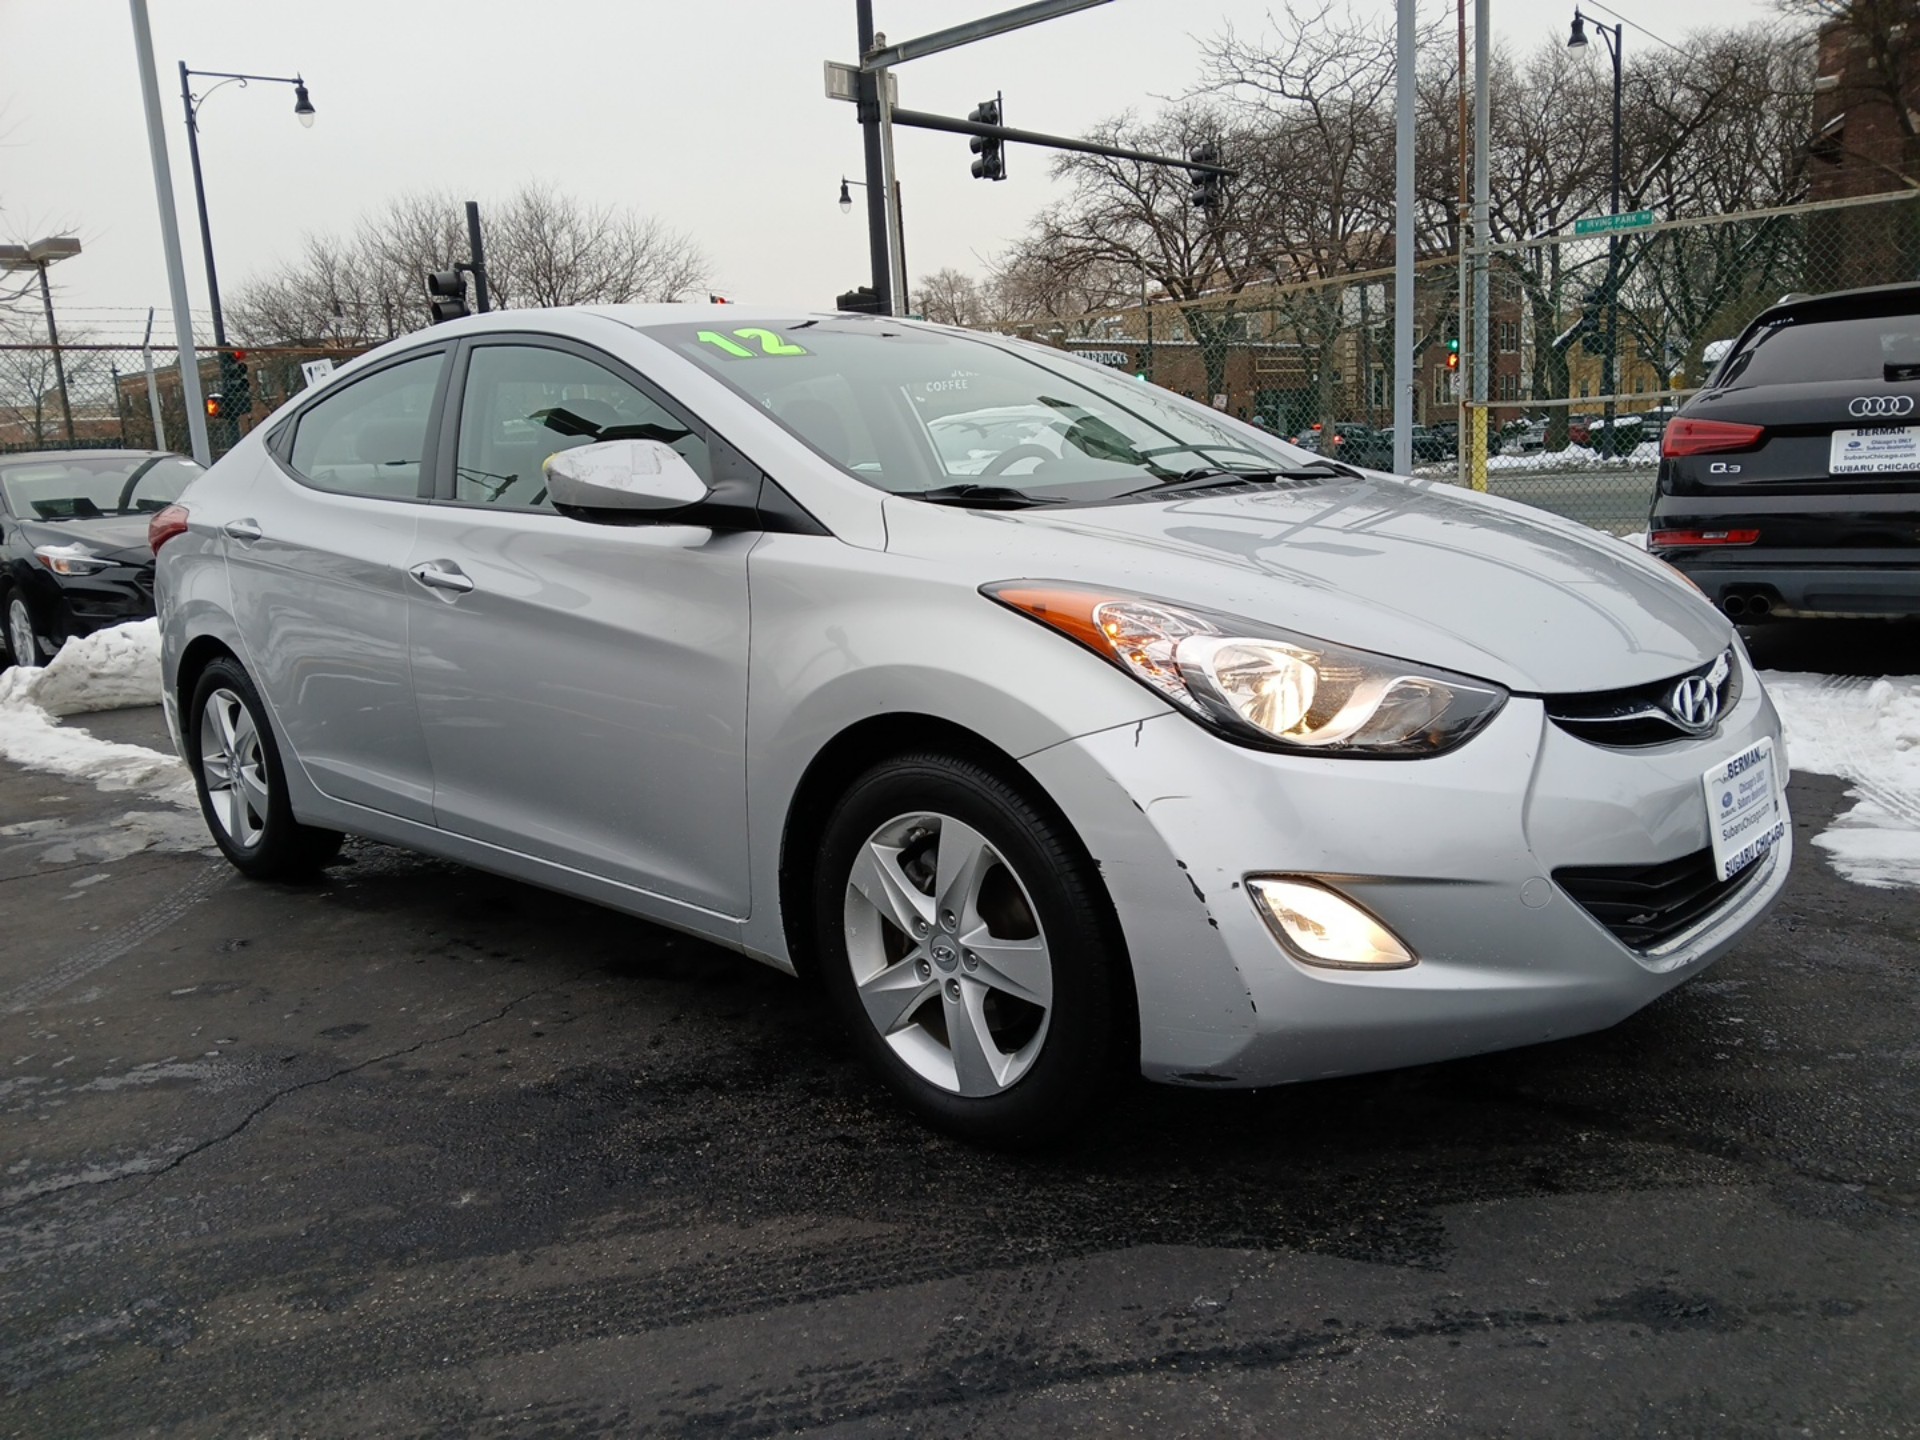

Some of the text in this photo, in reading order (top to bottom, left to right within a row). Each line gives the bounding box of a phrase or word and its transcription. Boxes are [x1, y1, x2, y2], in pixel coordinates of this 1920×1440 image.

[1587, 218, 1613, 228] IRVING
[1615, 214, 1637, 225] PARK
[697, 327, 807, 357] 12
[1072, 351, 1129, 365] ARBUCKS
[926, 380, 969, 393] COFFEE
[1857, 427, 1905, 436] BERMAN
[1844, 452, 1917, 461] SubaruChicago.com
[1710, 462, 1741, 474] Q3
[1833, 464, 1874, 474] SUBARU
[1727, 747, 1761, 779] BERMAN
[1722, 803, 1770, 841] SubaruChicago.com
[1724, 821, 1785, 878] SUBARU CHICAGO
